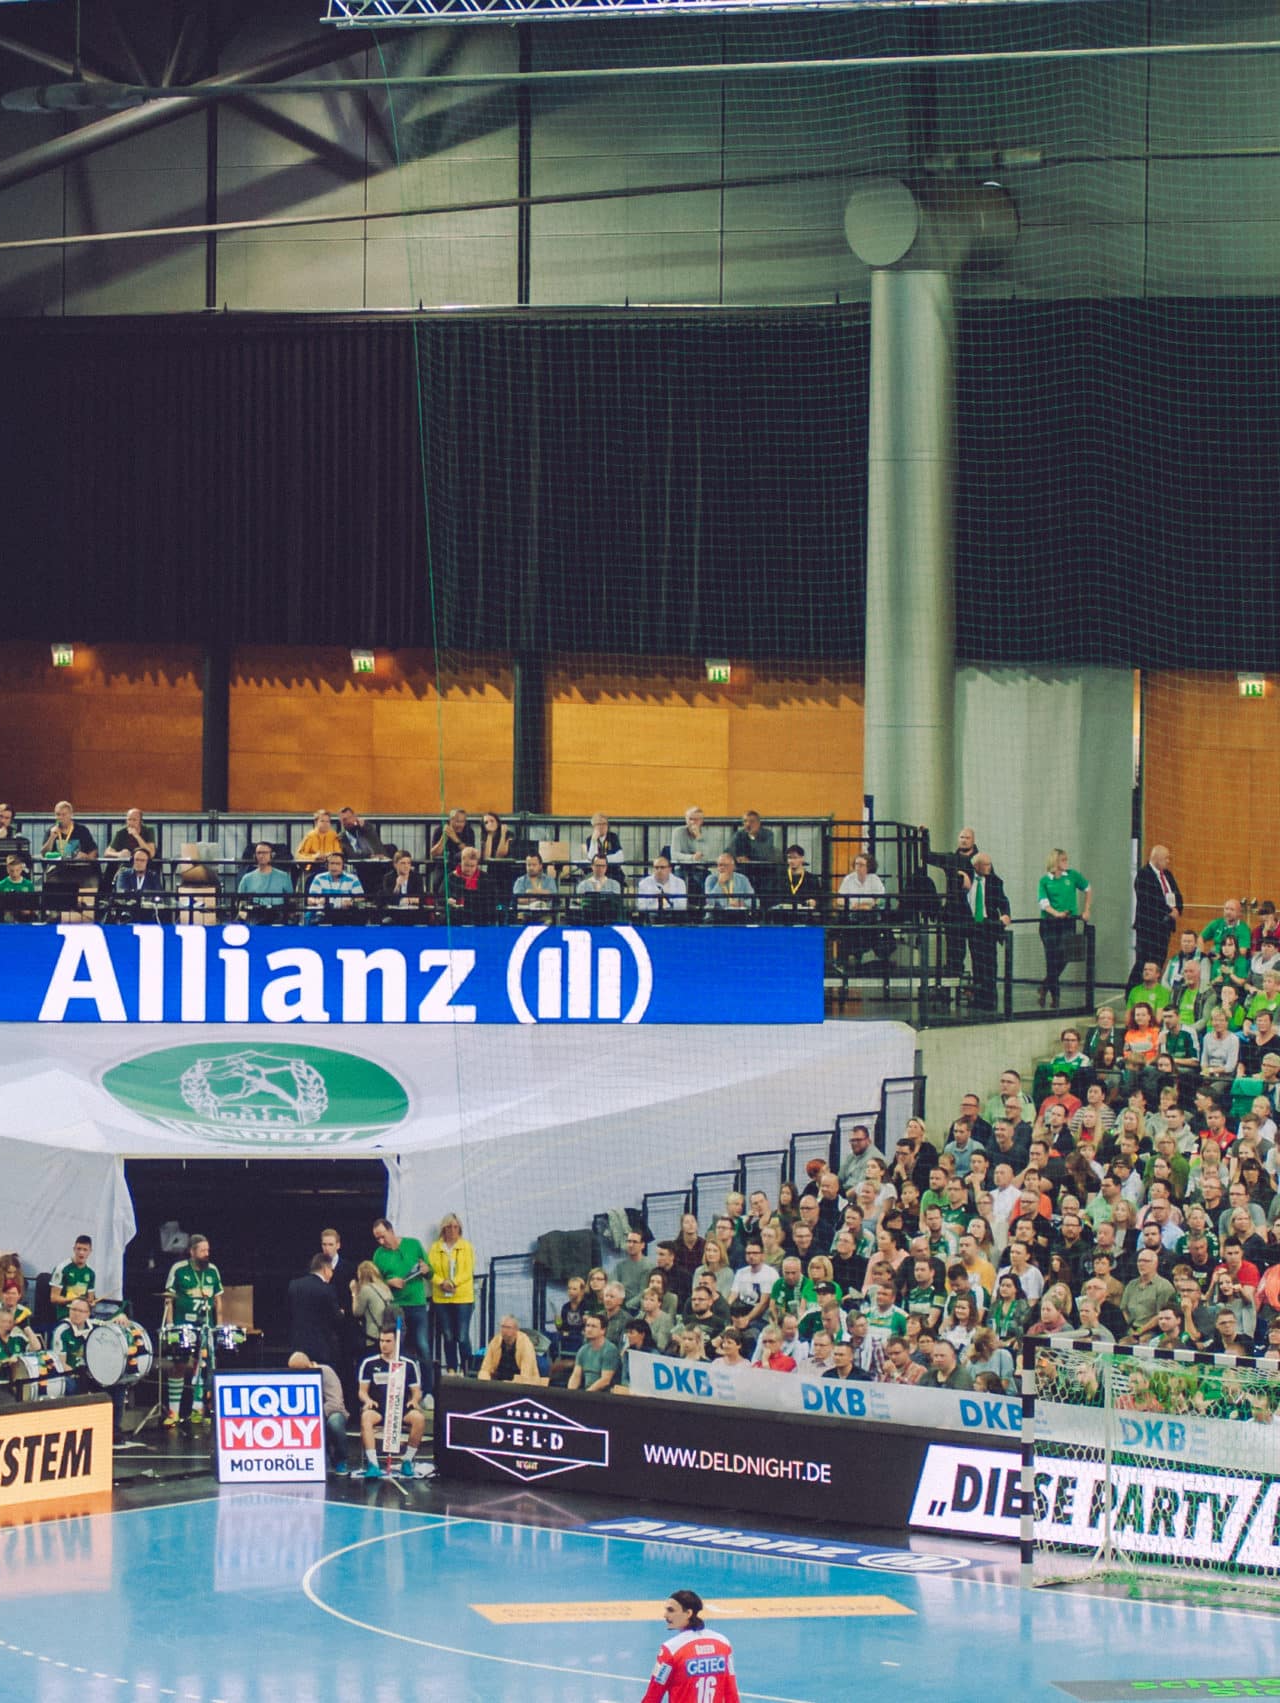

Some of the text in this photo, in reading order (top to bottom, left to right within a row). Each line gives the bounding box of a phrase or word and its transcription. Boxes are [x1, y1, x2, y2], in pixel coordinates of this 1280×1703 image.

[38, 924, 478, 1024] Allianz
[653, 1362, 713, 1397] DKB
[222, 1386, 316, 1418] LIQUI
[801, 1384, 867, 1417] DKB
[225, 1418, 320, 1448] MOLY
[1120, 1417, 1186, 1452] DKB
[230, 1454, 314, 1473] MOTORÖLE
[643, 1444, 832, 1483] WWW.DELDNIGHT.DE
[1088, 1478, 1239, 1543] PARTY
[588, 1520, 862, 1558] Allianz
